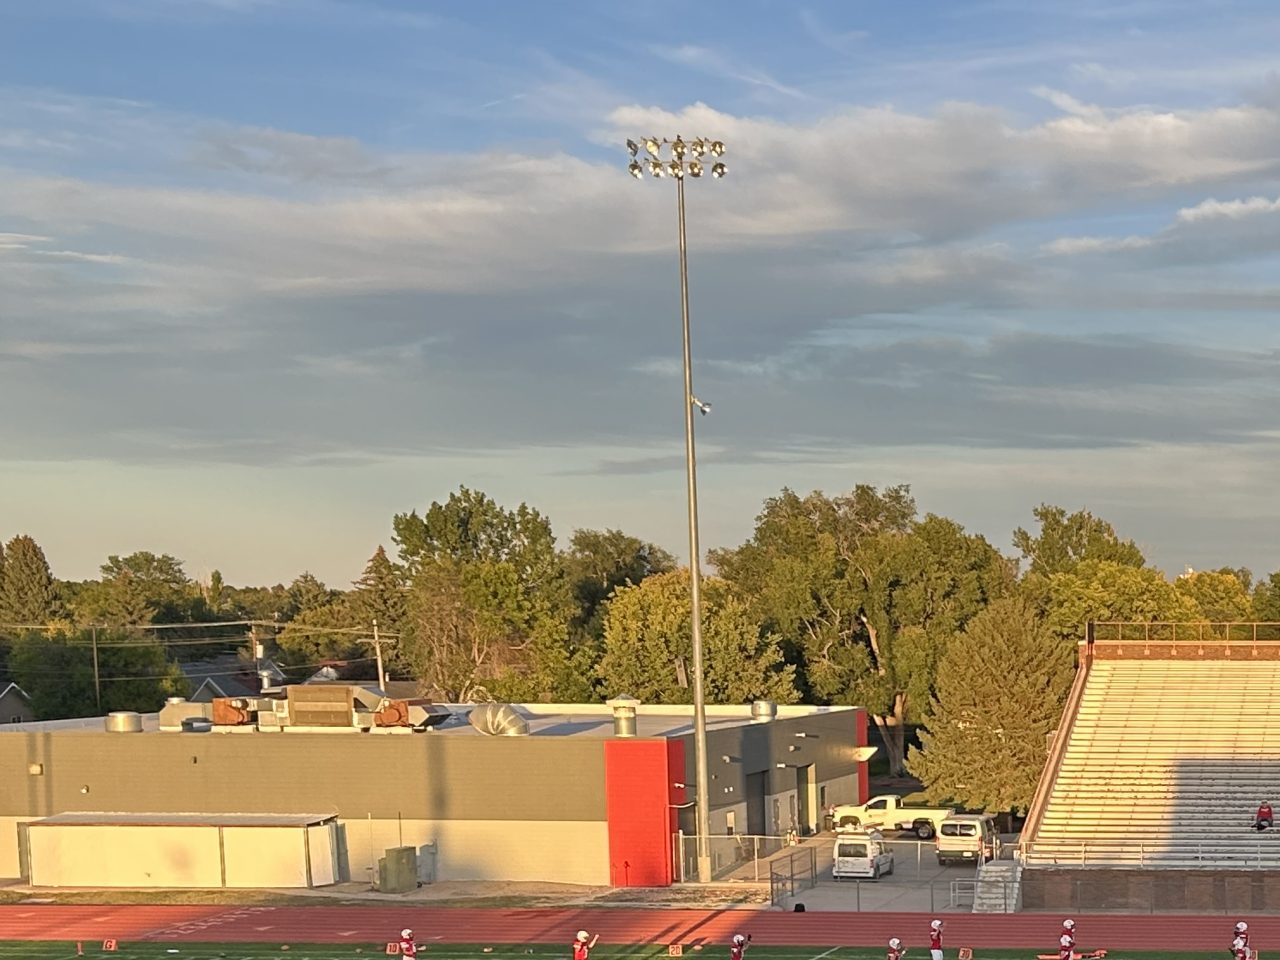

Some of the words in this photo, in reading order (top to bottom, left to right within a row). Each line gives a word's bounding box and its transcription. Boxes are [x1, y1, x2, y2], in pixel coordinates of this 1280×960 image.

[105, 940, 113, 950] G
[670, 946, 681, 956] 20
[960, 949, 971, 959] 30
